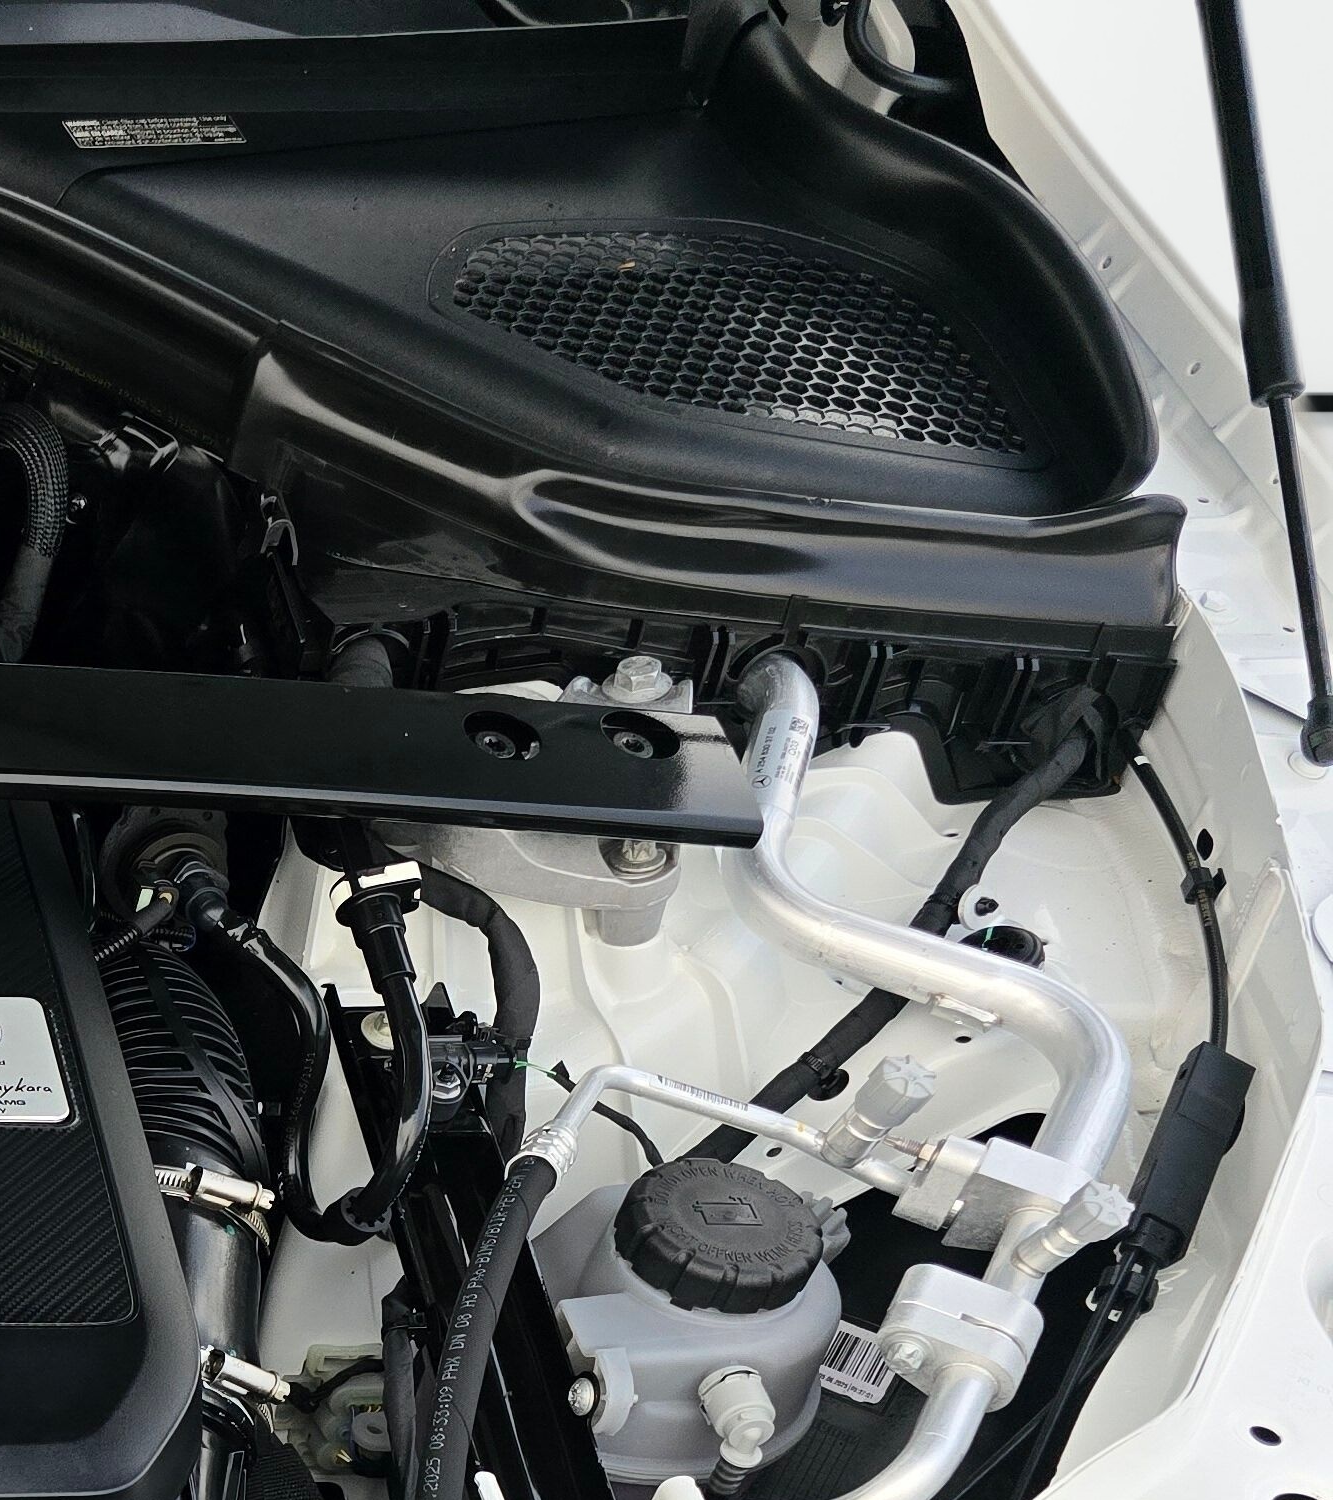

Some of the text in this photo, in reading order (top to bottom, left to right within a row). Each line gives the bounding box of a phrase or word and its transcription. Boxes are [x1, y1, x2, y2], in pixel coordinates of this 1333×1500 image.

[454, 1312, 473, 1329] 08
[448, 1332, 467, 1351] DN
[442, 1355, 462, 1380] PHX
[430, 1384, 454, 1452] 08:33:09
